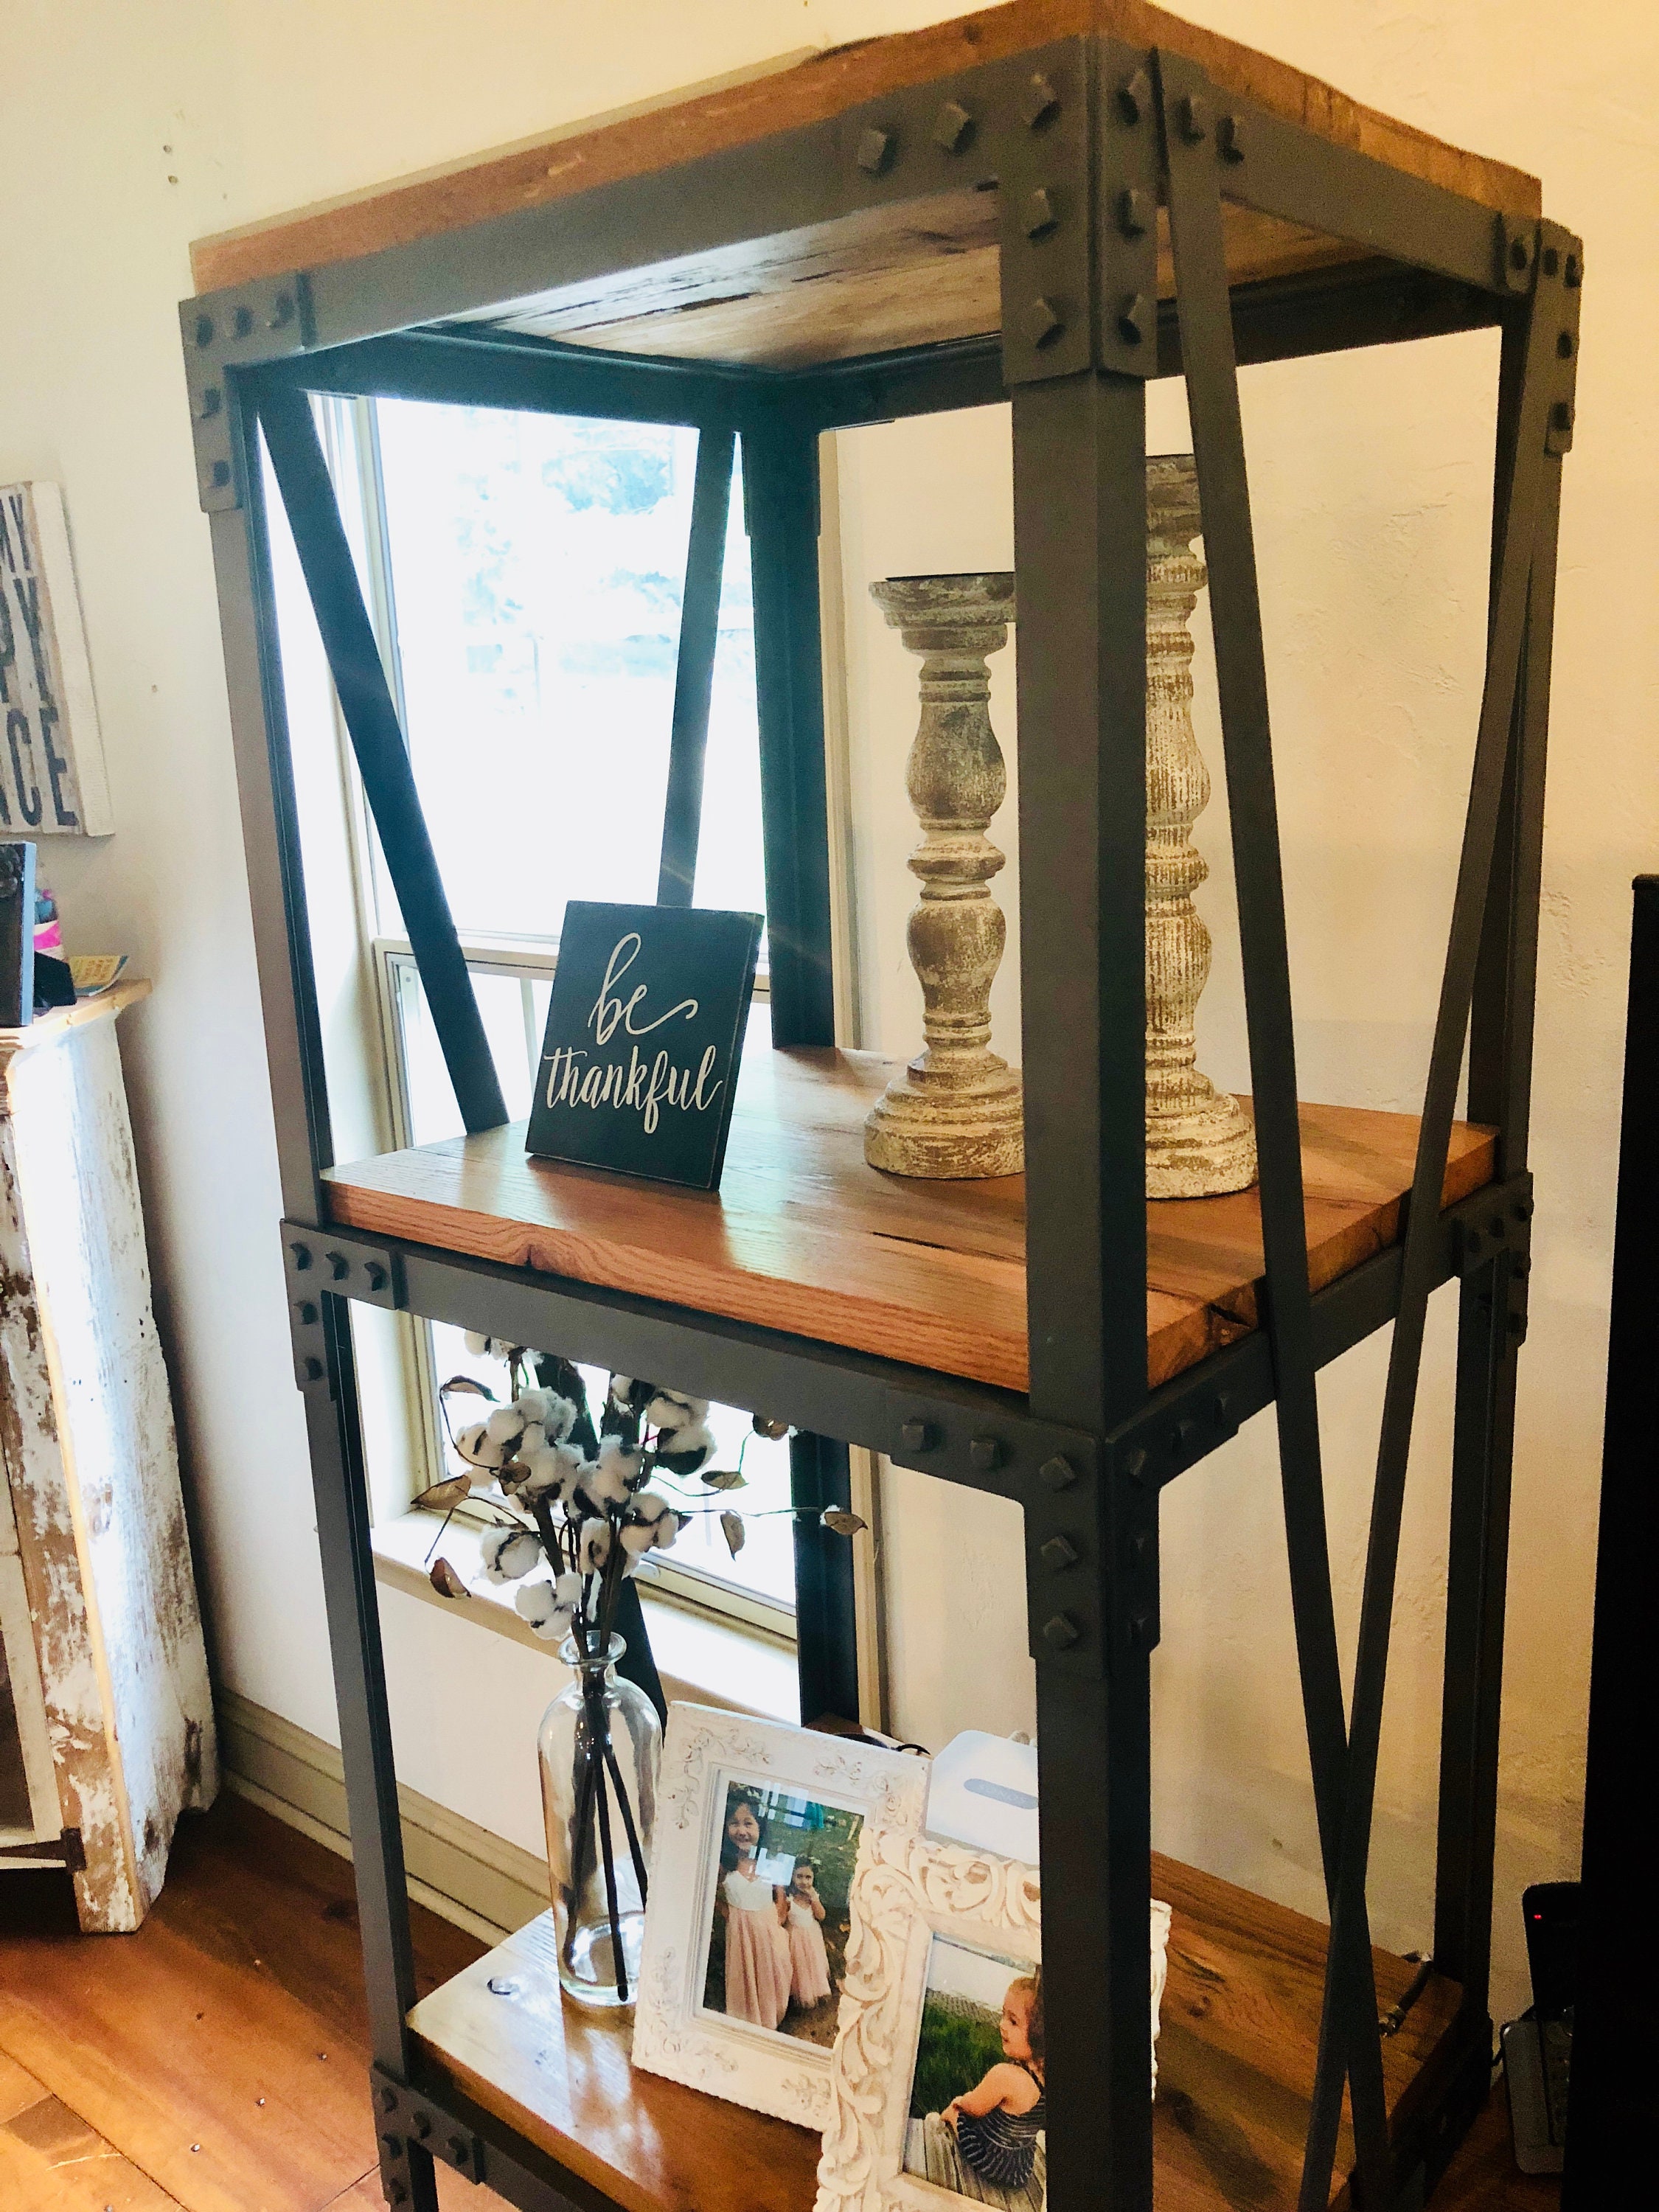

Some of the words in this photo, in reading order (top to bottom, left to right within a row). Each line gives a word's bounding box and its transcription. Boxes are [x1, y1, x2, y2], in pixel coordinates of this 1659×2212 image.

[0, 708, 79, 826] CE
[588, 932, 698, 1046] be
[543, 1045, 723, 1134] thankful
